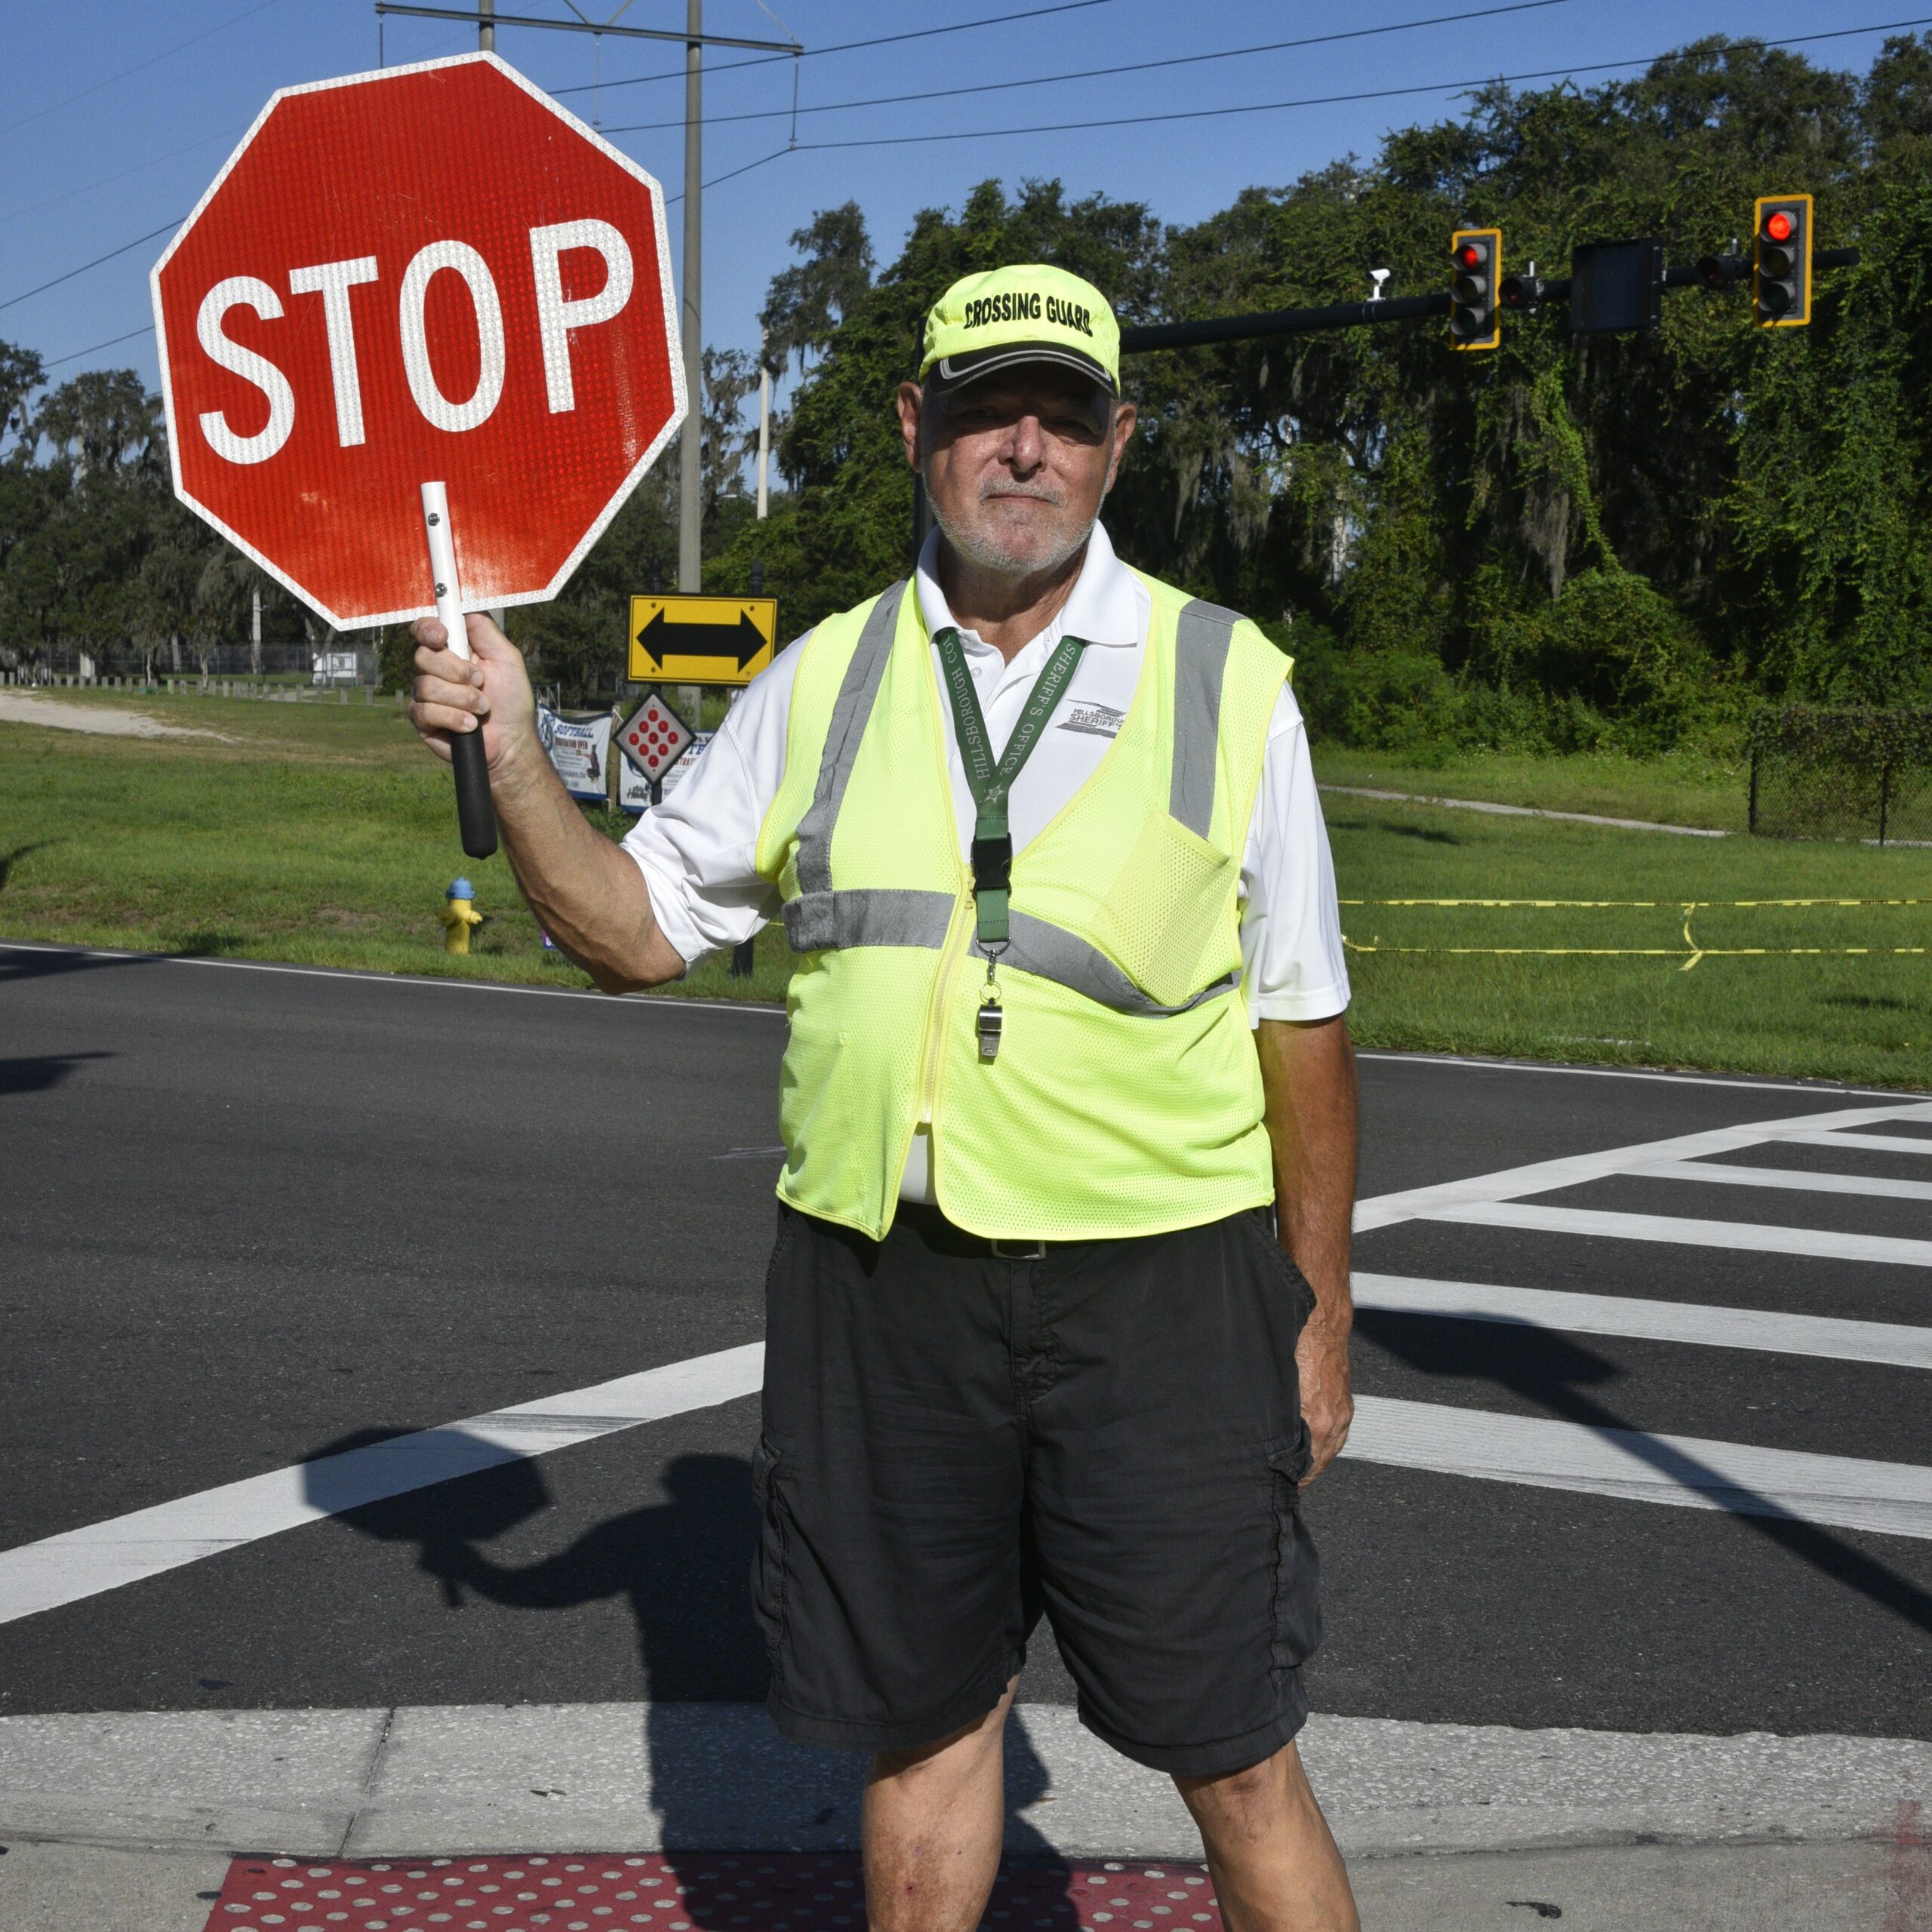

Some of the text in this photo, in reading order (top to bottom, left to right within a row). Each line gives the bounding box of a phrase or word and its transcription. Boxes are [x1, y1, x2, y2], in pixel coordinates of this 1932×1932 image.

[196, 217, 635, 466] STOP
[963, 293, 1094, 337] CROSSING GUARD
[554, 724, 594, 739] SOFTBALL
[951, 666, 990, 780] HILLSBOROUGH
[999, 643, 1076, 776] SHERIFF'S OFFICE
[1073, 708, 1125, 724] HILLSBOROU
